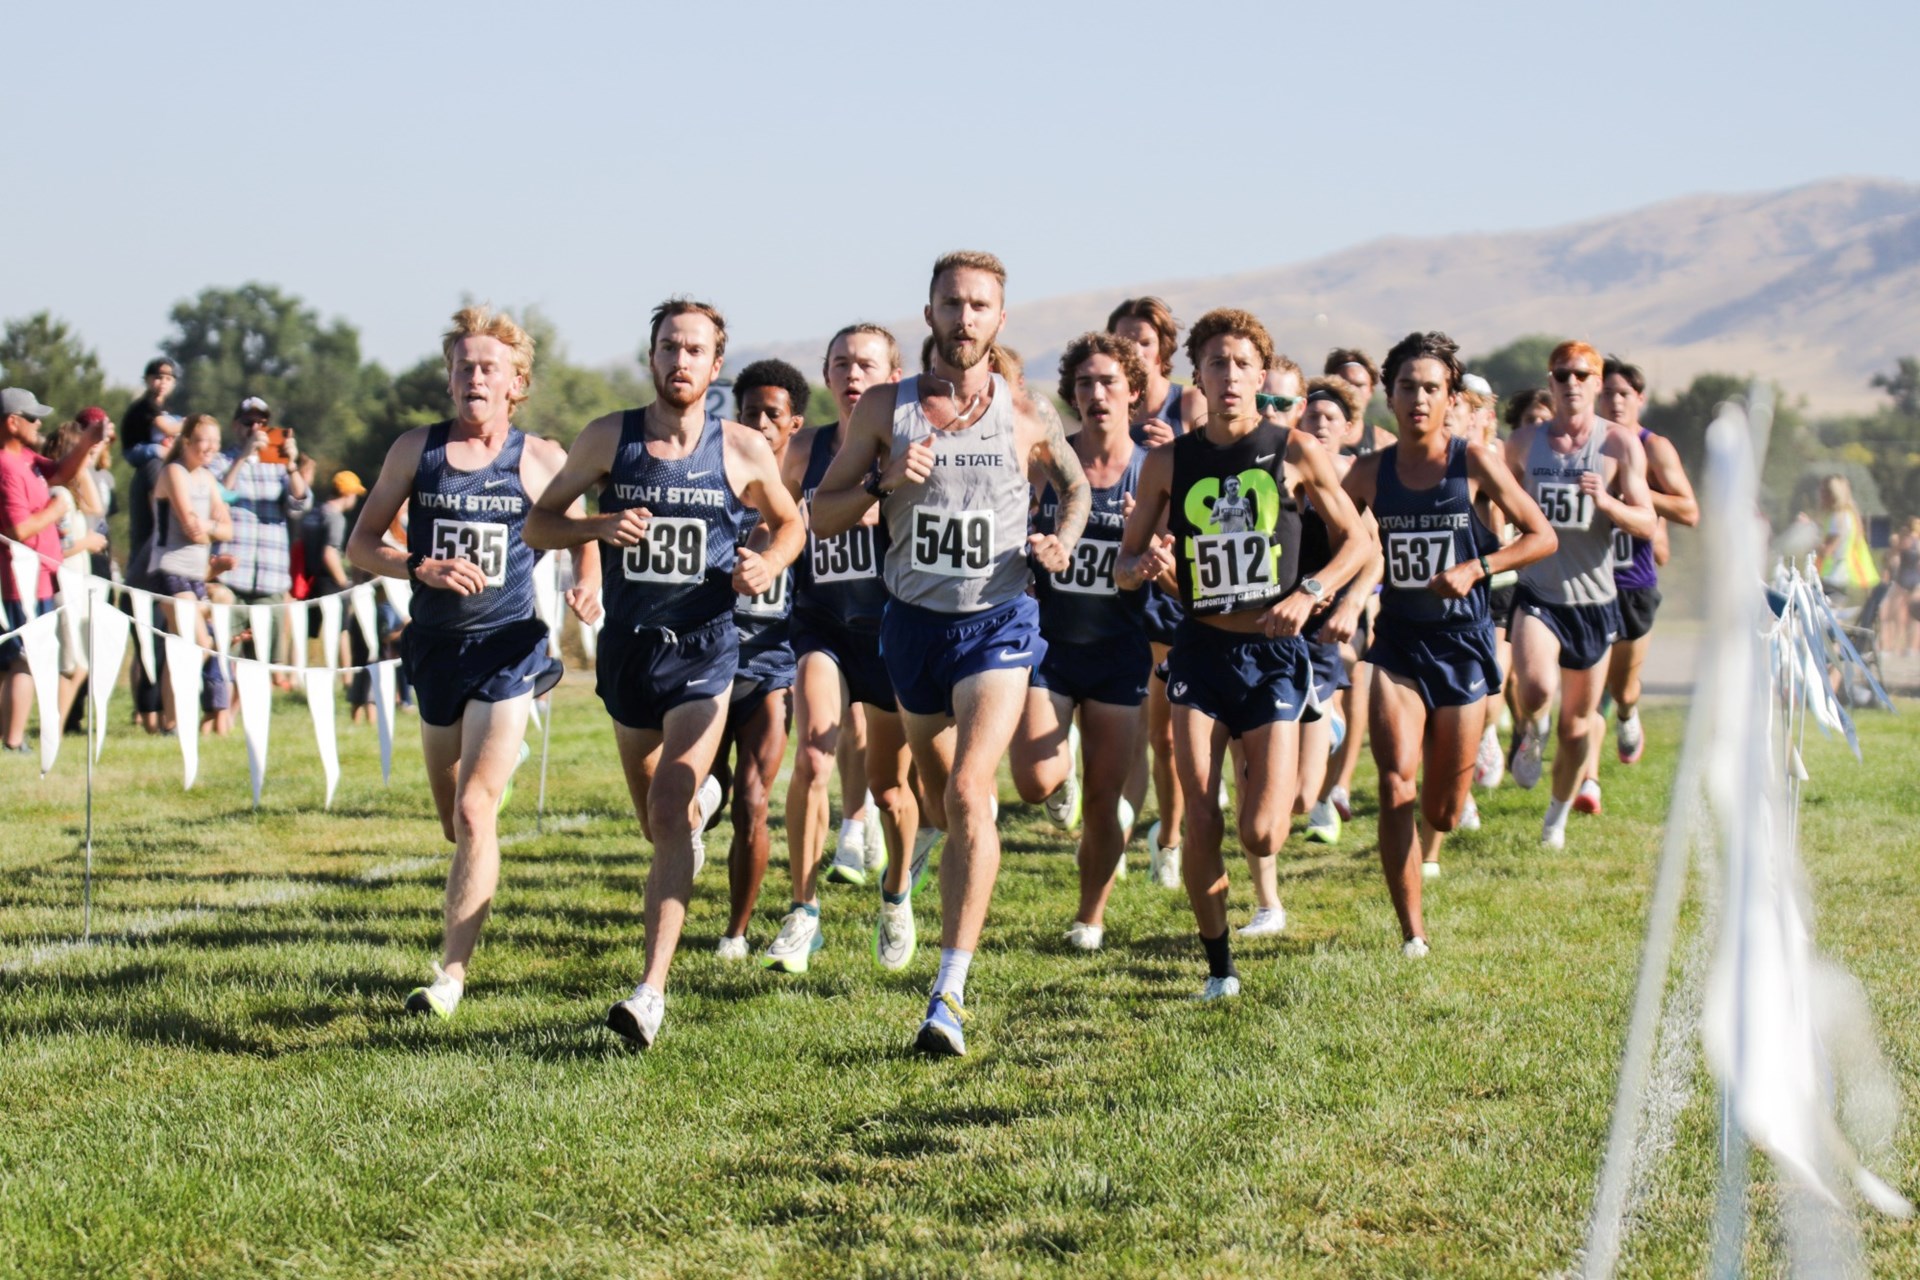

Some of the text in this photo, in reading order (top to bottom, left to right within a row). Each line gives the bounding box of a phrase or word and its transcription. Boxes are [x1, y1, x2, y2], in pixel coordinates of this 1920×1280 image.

[955, 454, 1004, 467] STATE
[418, 491, 522, 513] UTAH STATE
[615, 484, 725, 507] UTAH STATE
[1541, 487, 1585, 523] 551
[916, 512, 990, 570] 549
[1379, 513, 1469, 531] UTAH STATE
[436, 524, 504, 577] 535
[627, 523, 702, 576] 539
[814, 525, 872, 576] 530
[1198, 536, 1269, 588] 512
[1391, 537, 1451, 582] 537
